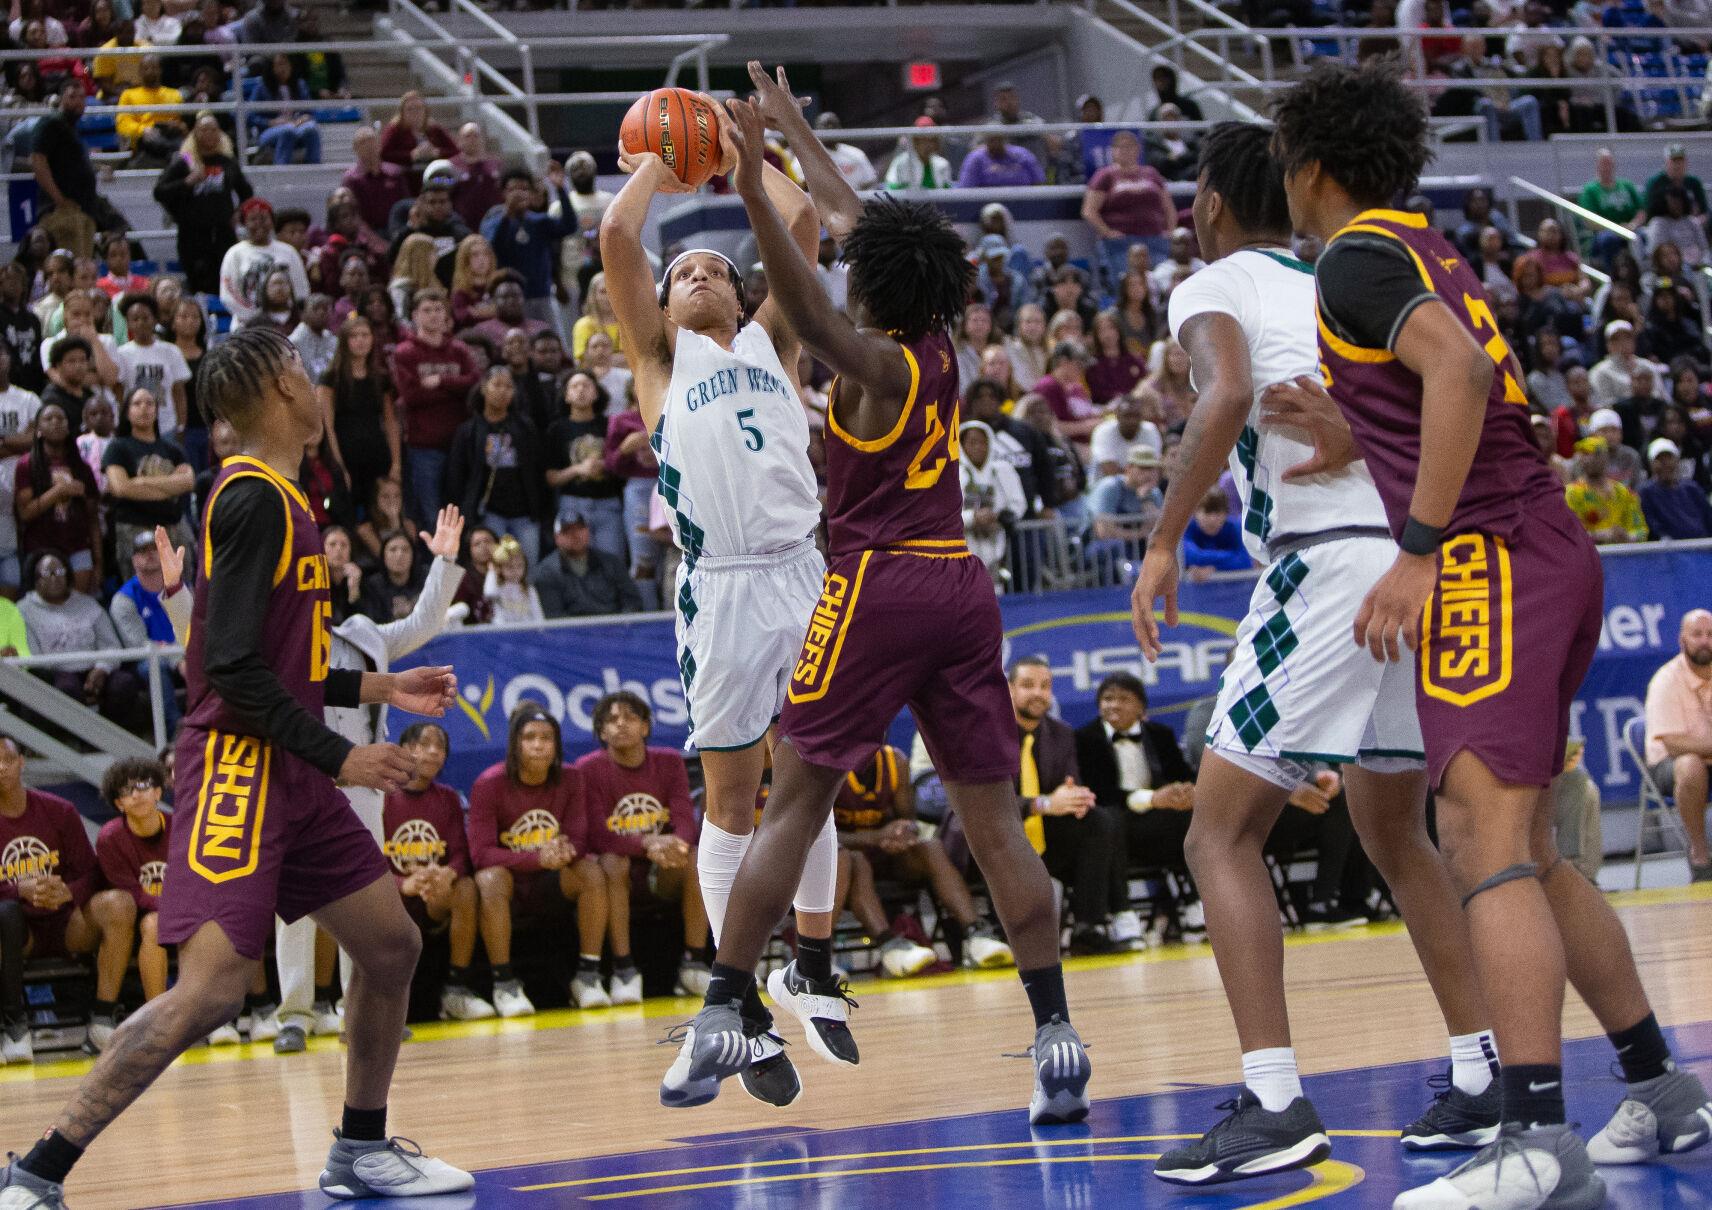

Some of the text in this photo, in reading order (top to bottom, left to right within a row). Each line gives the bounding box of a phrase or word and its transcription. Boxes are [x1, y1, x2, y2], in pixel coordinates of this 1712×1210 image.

[20, 198, 33, 224] 1
[686, 368, 739, 412] GREEN
[736, 407, 765, 454] 5
[793, 573, 849, 686] CHIEFS
[1440, 533, 1490, 678] CHIEFS
[202, 734, 260, 860] NCHS
